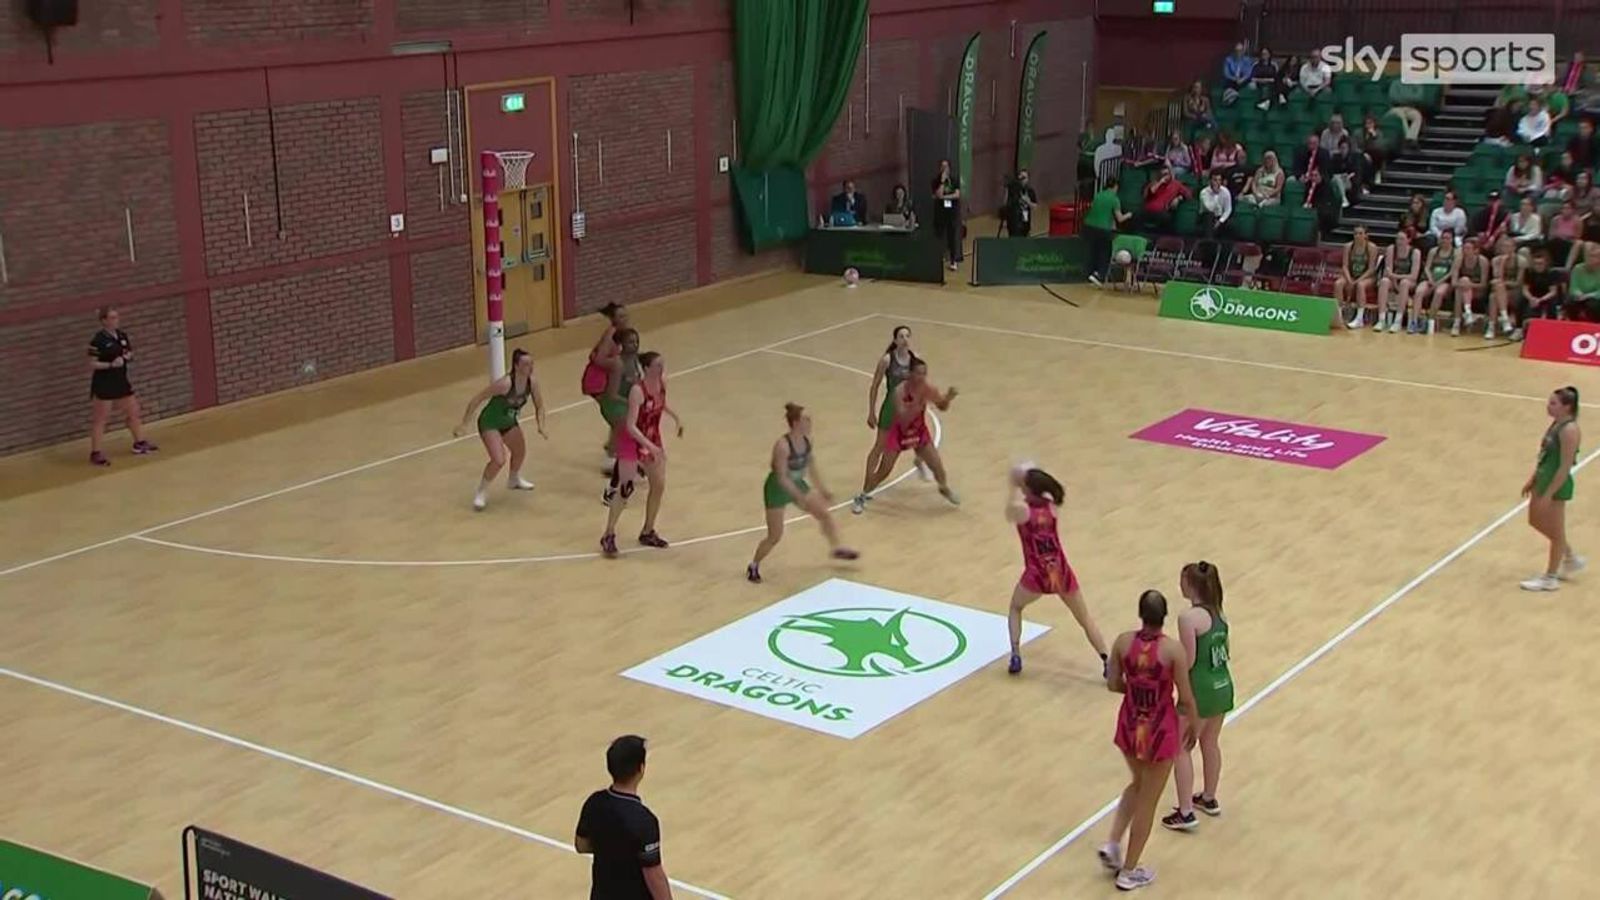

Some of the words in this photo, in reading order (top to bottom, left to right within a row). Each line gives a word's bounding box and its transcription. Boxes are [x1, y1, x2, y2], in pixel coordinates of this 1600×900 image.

[1223, 302, 1298, 322] DRAGONS
[1193, 418, 1335, 450] Vitality
[663, 664, 854, 721] DRAGONS
[741, 667, 823, 694] CELTIC
[203, 868, 248, 896] SPORT
